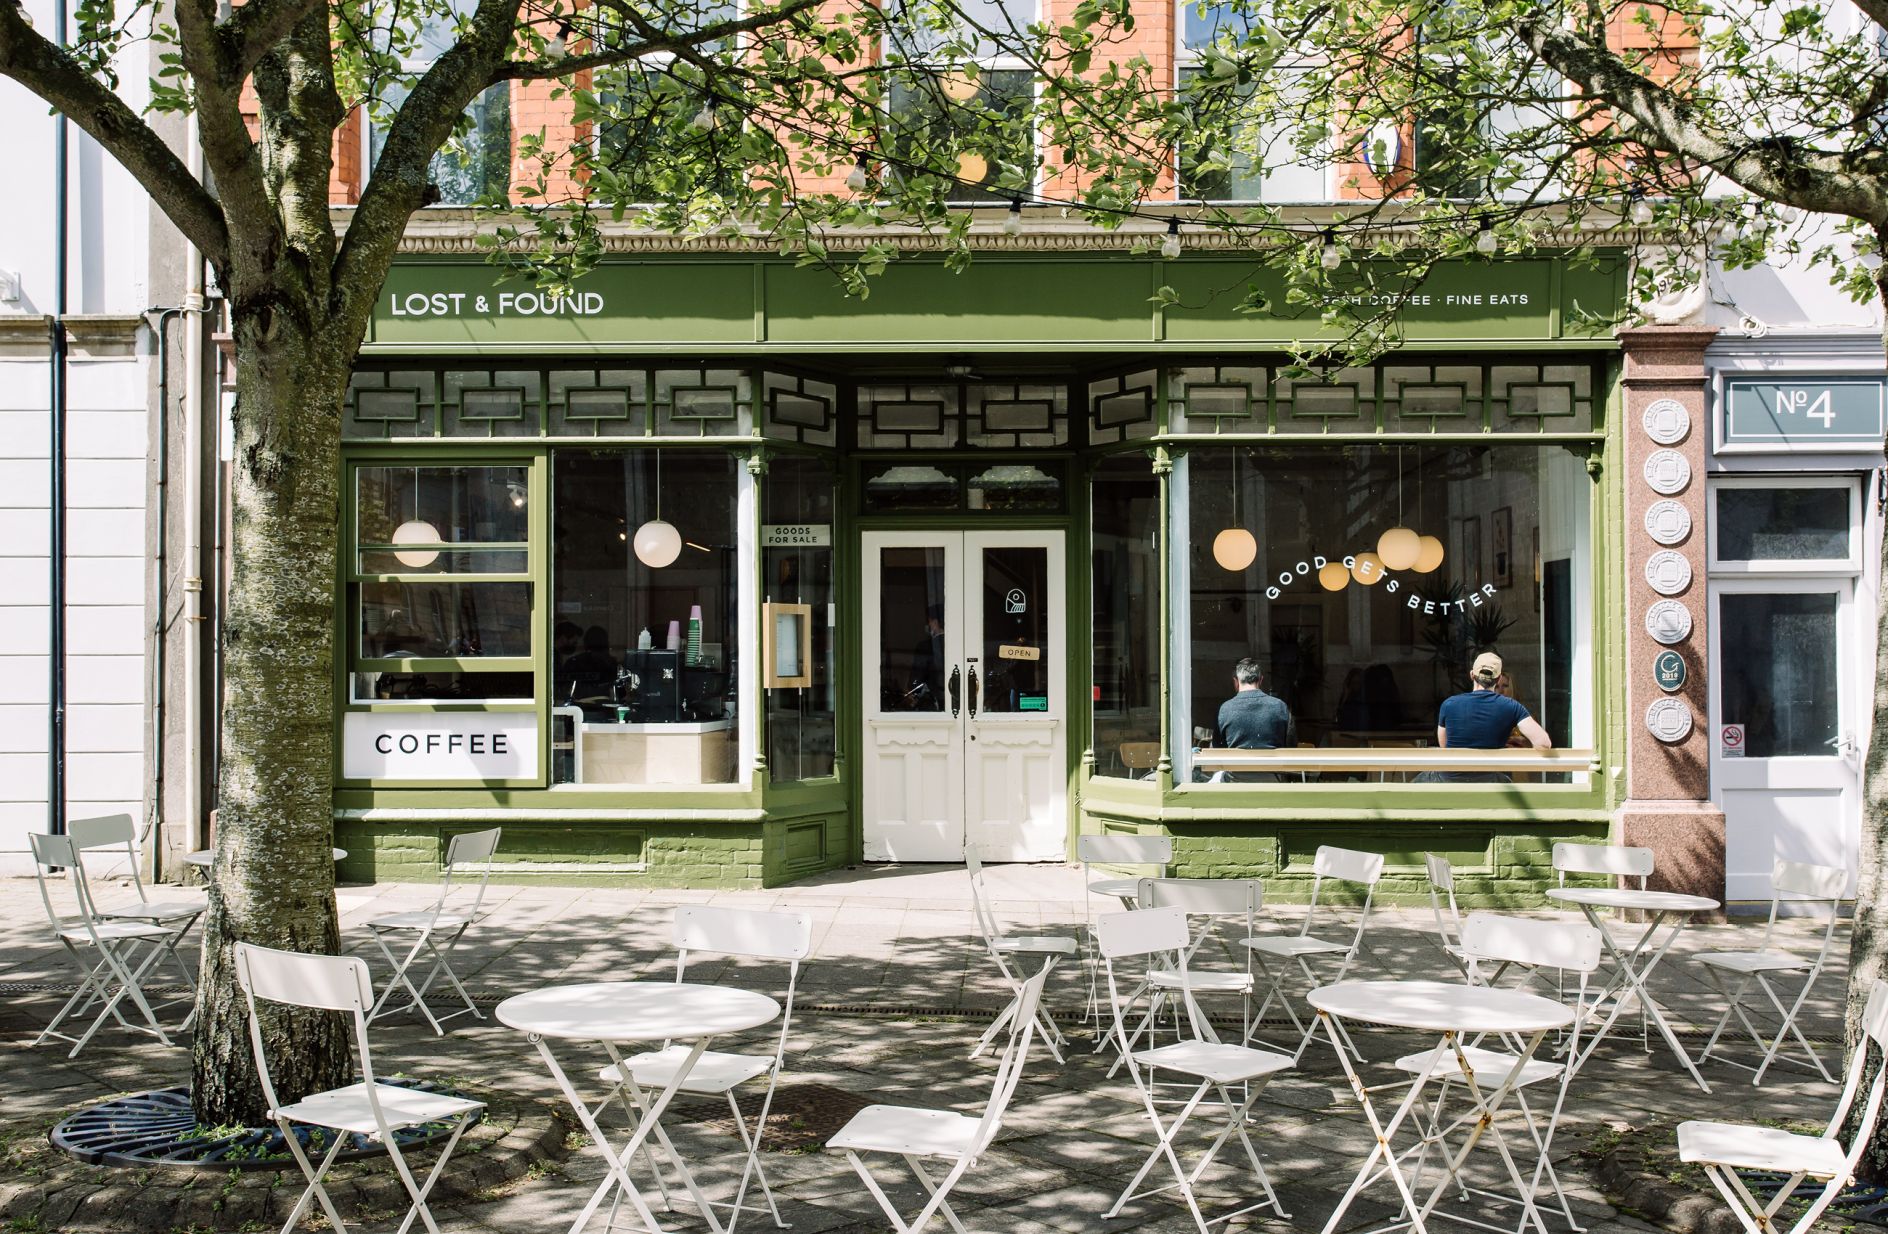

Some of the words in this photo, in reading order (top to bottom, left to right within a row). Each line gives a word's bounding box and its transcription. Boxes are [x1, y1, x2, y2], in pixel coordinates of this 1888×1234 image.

[391, 293, 466, 315] LOST
[475, 295, 490, 314] &
[499, 292, 604, 315] FOUND
[1446, 294, 1482, 305] FINE
[1489, 294, 1529, 305] EATS
[775, 527, 811, 535] GOODS
[768, 536, 789, 544] FOR
[792, 536, 818, 544] SALE
[1265, 555, 1327, 600] GOOD
[1342, 555, 1400, 593] GETS
[1407, 583, 1497, 616] BETTER
[1007, 648, 1032, 658] OPEN
[375, 734, 508, 754] COFFEE
